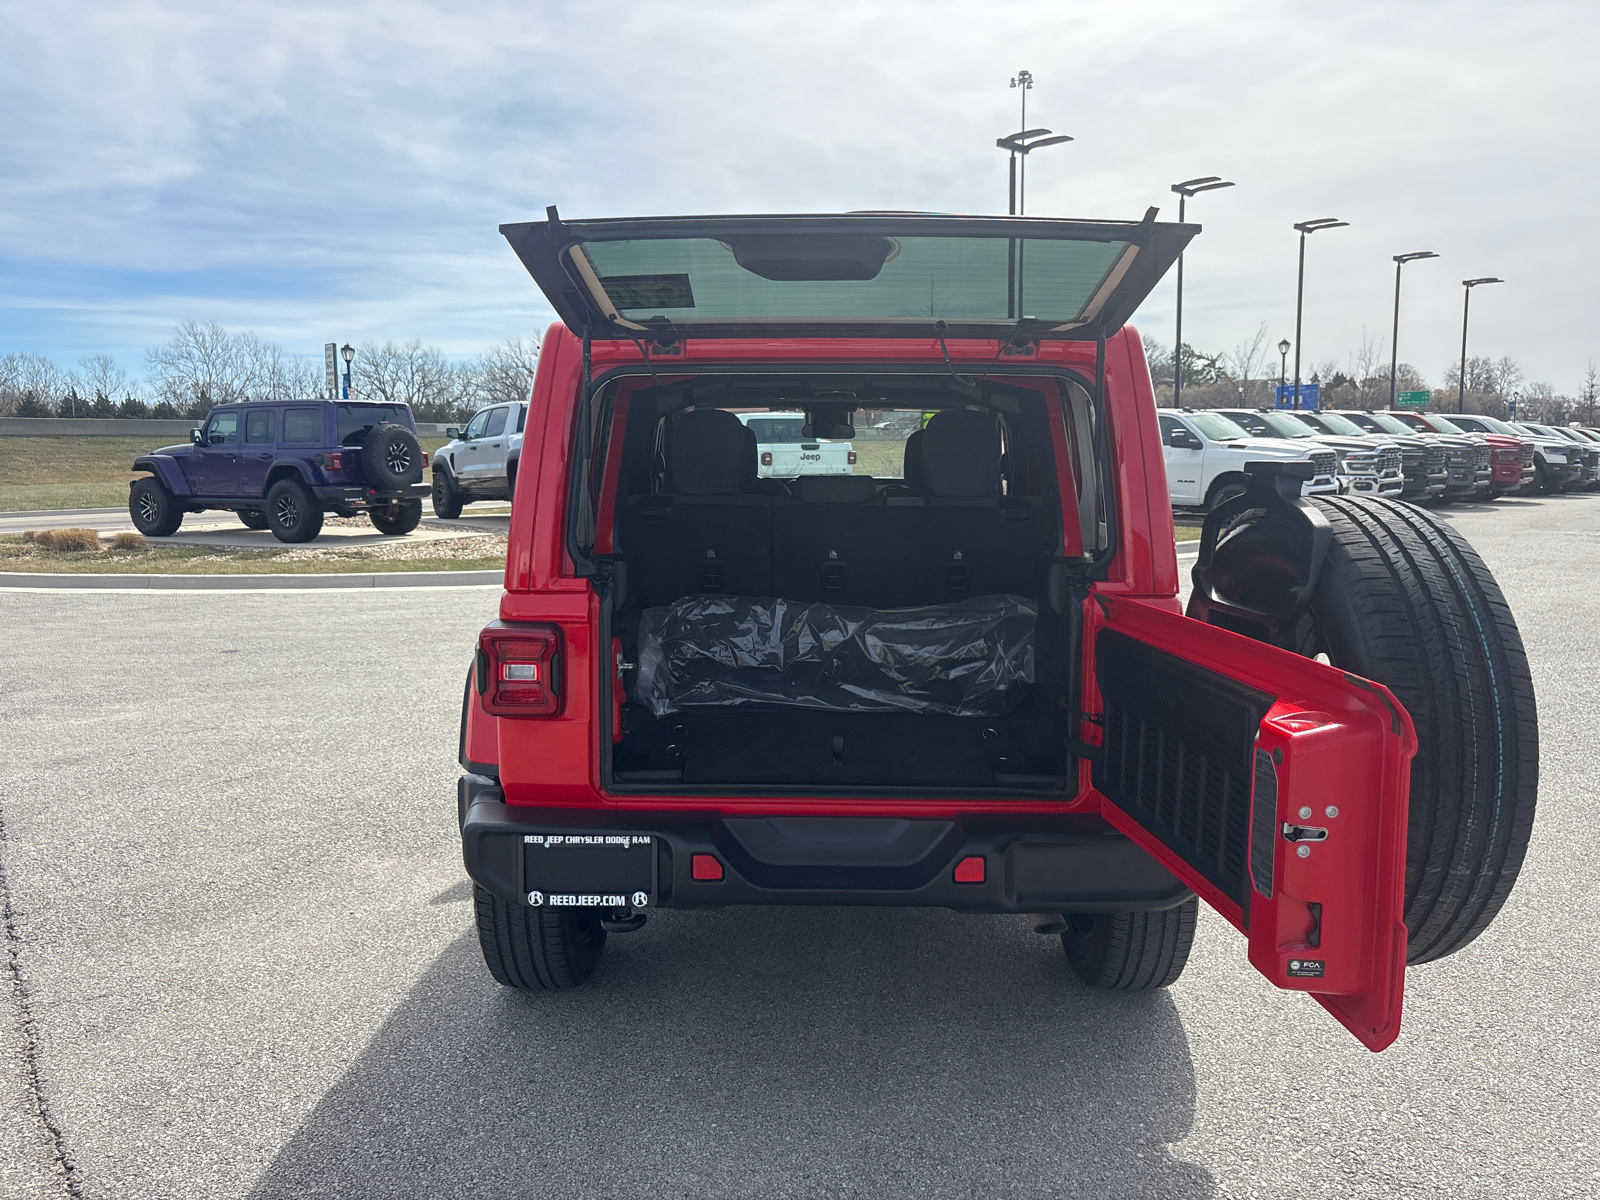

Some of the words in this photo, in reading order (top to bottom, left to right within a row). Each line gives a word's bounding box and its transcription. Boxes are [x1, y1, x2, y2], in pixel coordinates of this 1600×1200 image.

[800, 453, 821, 461] Jeep
[524, 835, 543, 844] REED
[546, 835, 563, 845] JEEP
[565, 835, 604, 844] CHRYSLER
[605, 835, 631, 845] DODGE
[632, 836, 651, 844] RAM
[550, 895, 626, 906] REEDJEEP.COM
